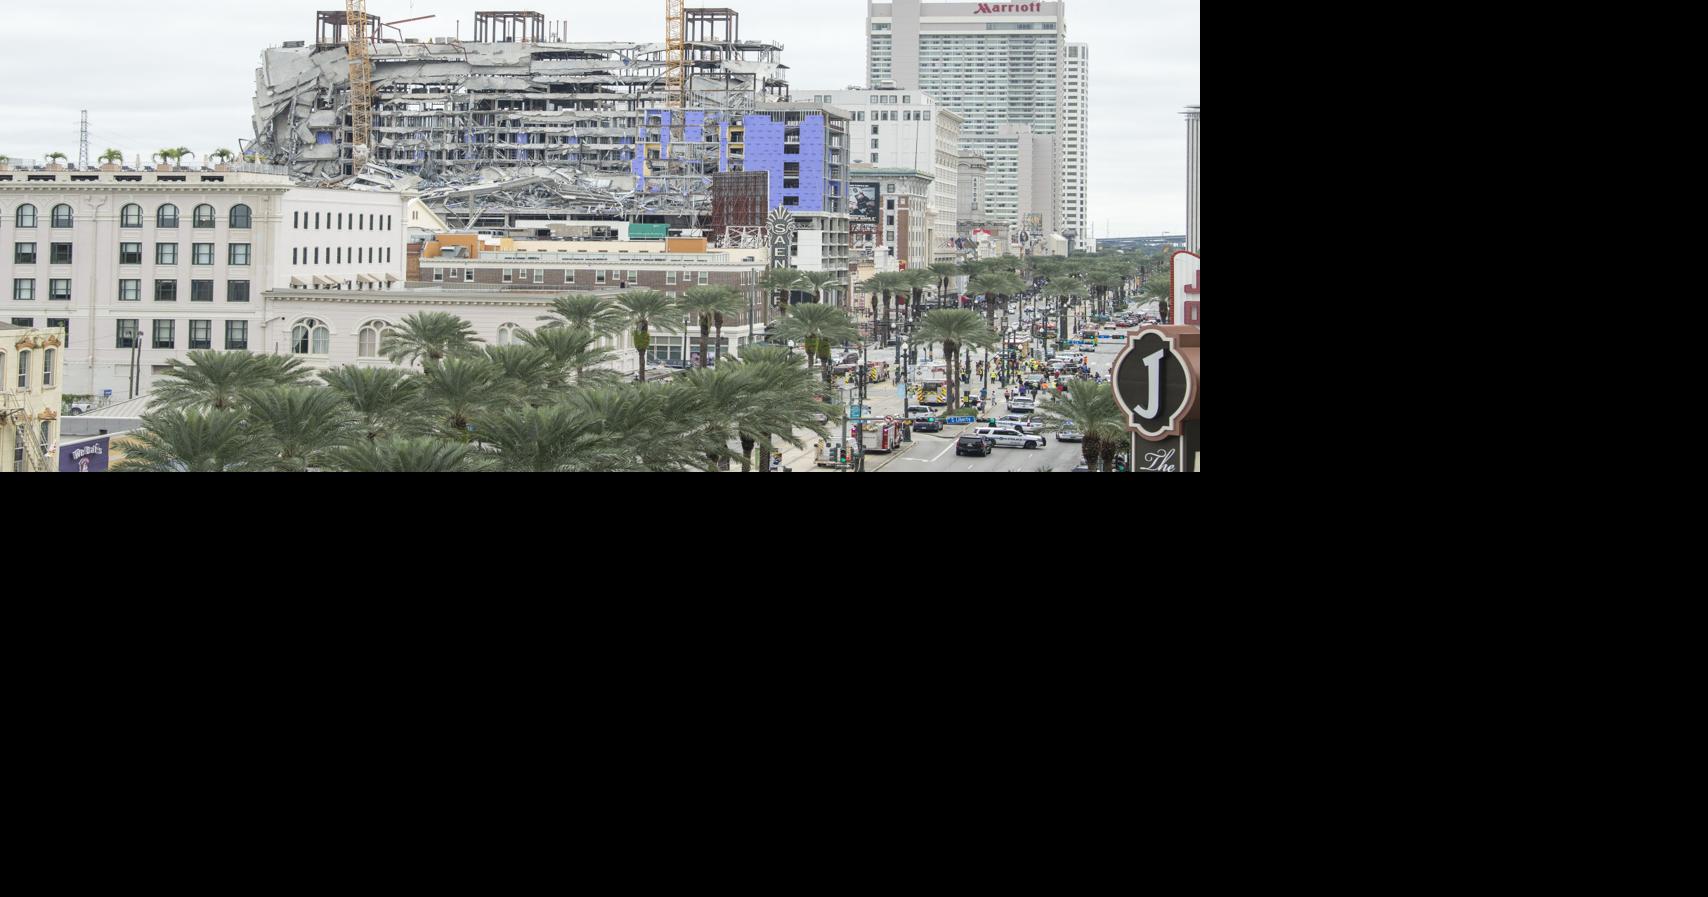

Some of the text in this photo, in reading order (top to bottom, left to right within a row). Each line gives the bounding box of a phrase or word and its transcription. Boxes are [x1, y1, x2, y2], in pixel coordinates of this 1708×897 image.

[973, 2, 1041, 14] Marriott
[1133, 348, 1164, 419] J
[1140, 448, 1176, 472] The
